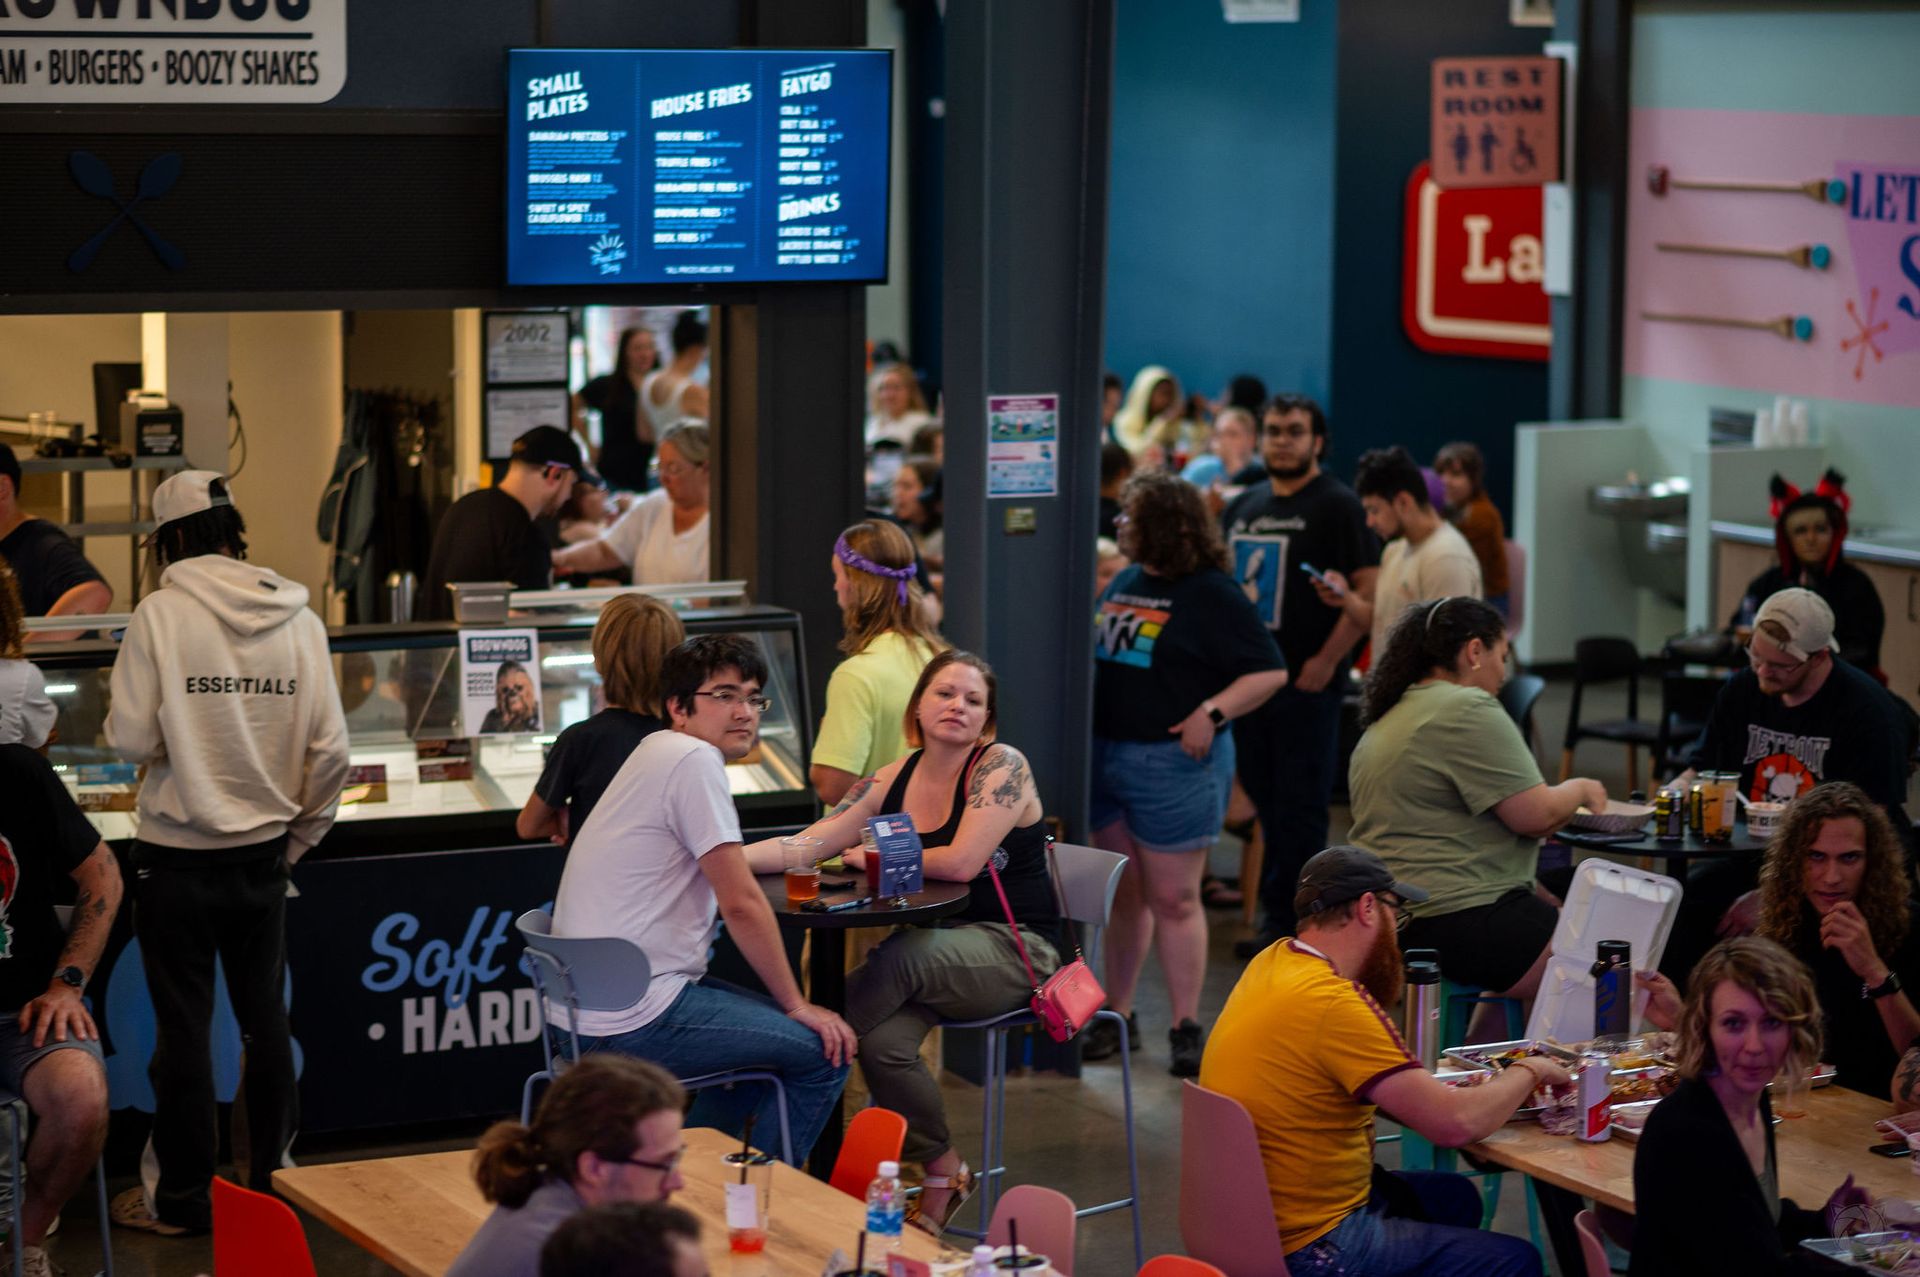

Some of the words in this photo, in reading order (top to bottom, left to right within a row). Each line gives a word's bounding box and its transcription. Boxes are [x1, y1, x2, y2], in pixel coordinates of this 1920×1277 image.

[48, 49, 144, 85] BURGERS
[165, 50, 236, 85] BOOZY
[241, 50, 320, 86] SHAKES
[1444, 66, 1546, 90] REST
[527, 70, 583, 99] SMALL
[780, 70, 832, 98] FAYGO
[527, 91, 590, 122] PLATES
[651, 91, 705, 119] HOUSE
[707, 82, 753, 109] FRIES
[1444, 95, 1544, 117] ROOM
[1461, 214, 1544, 284] La
[504, 322, 551, 344] 2002
[185, 676, 297, 696] ESSENTIALS
[1743, 724, 1832, 780] DETROIT
[360, 905, 512, 1010] Soft
[402, 986, 543, 1055] HARD
